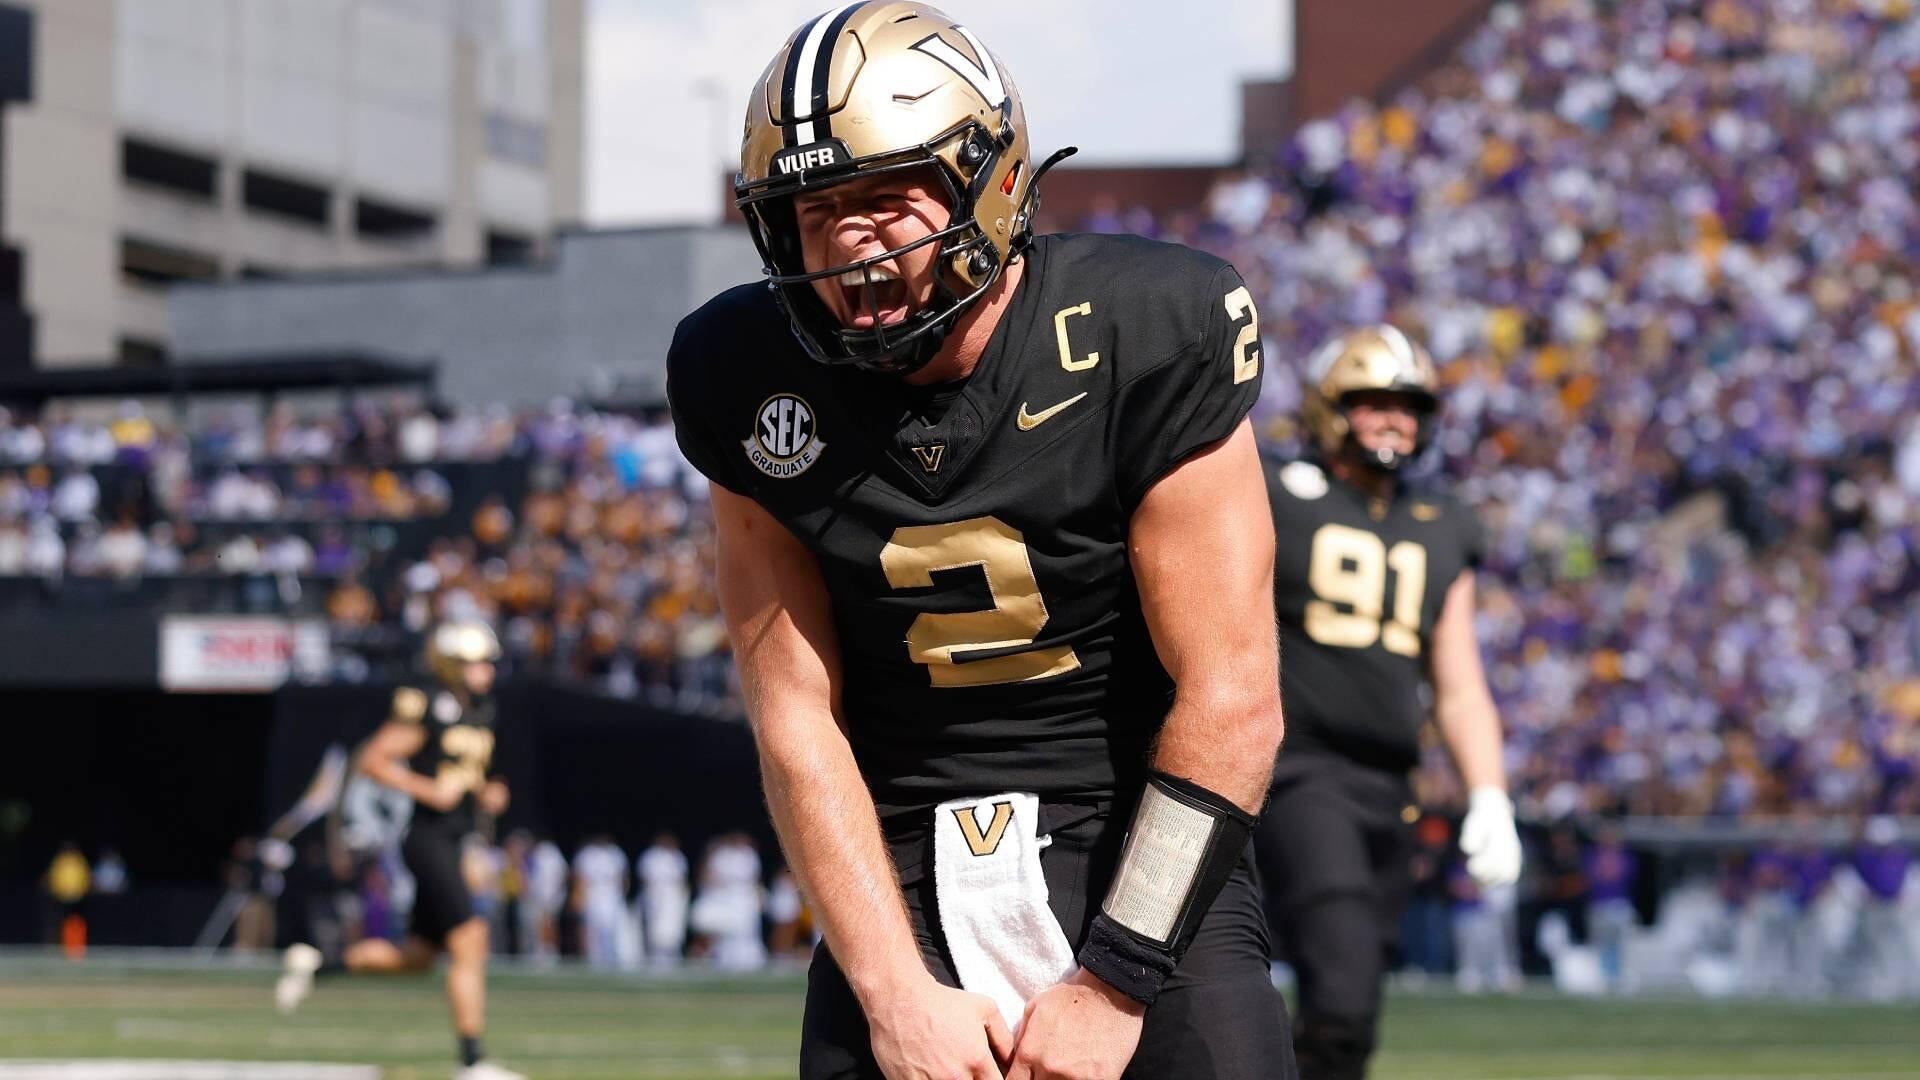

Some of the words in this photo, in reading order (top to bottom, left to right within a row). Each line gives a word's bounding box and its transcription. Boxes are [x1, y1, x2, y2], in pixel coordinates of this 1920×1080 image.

[907, 24, 1006, 112] V
[778, 147, 834, 174] VUFB
[1055, 302, 1099, 372] C
[1224, 286, 1260, 386] 2
[761, 399, 810, 455] SEC
[911, 445, 945, 472] V
[752, 450, 813, 475] GRADUATE
[879, 515, 1081, 688] 2
[1304, 522, 1427, 658] 91
[951, 801, 1014, 856] V
